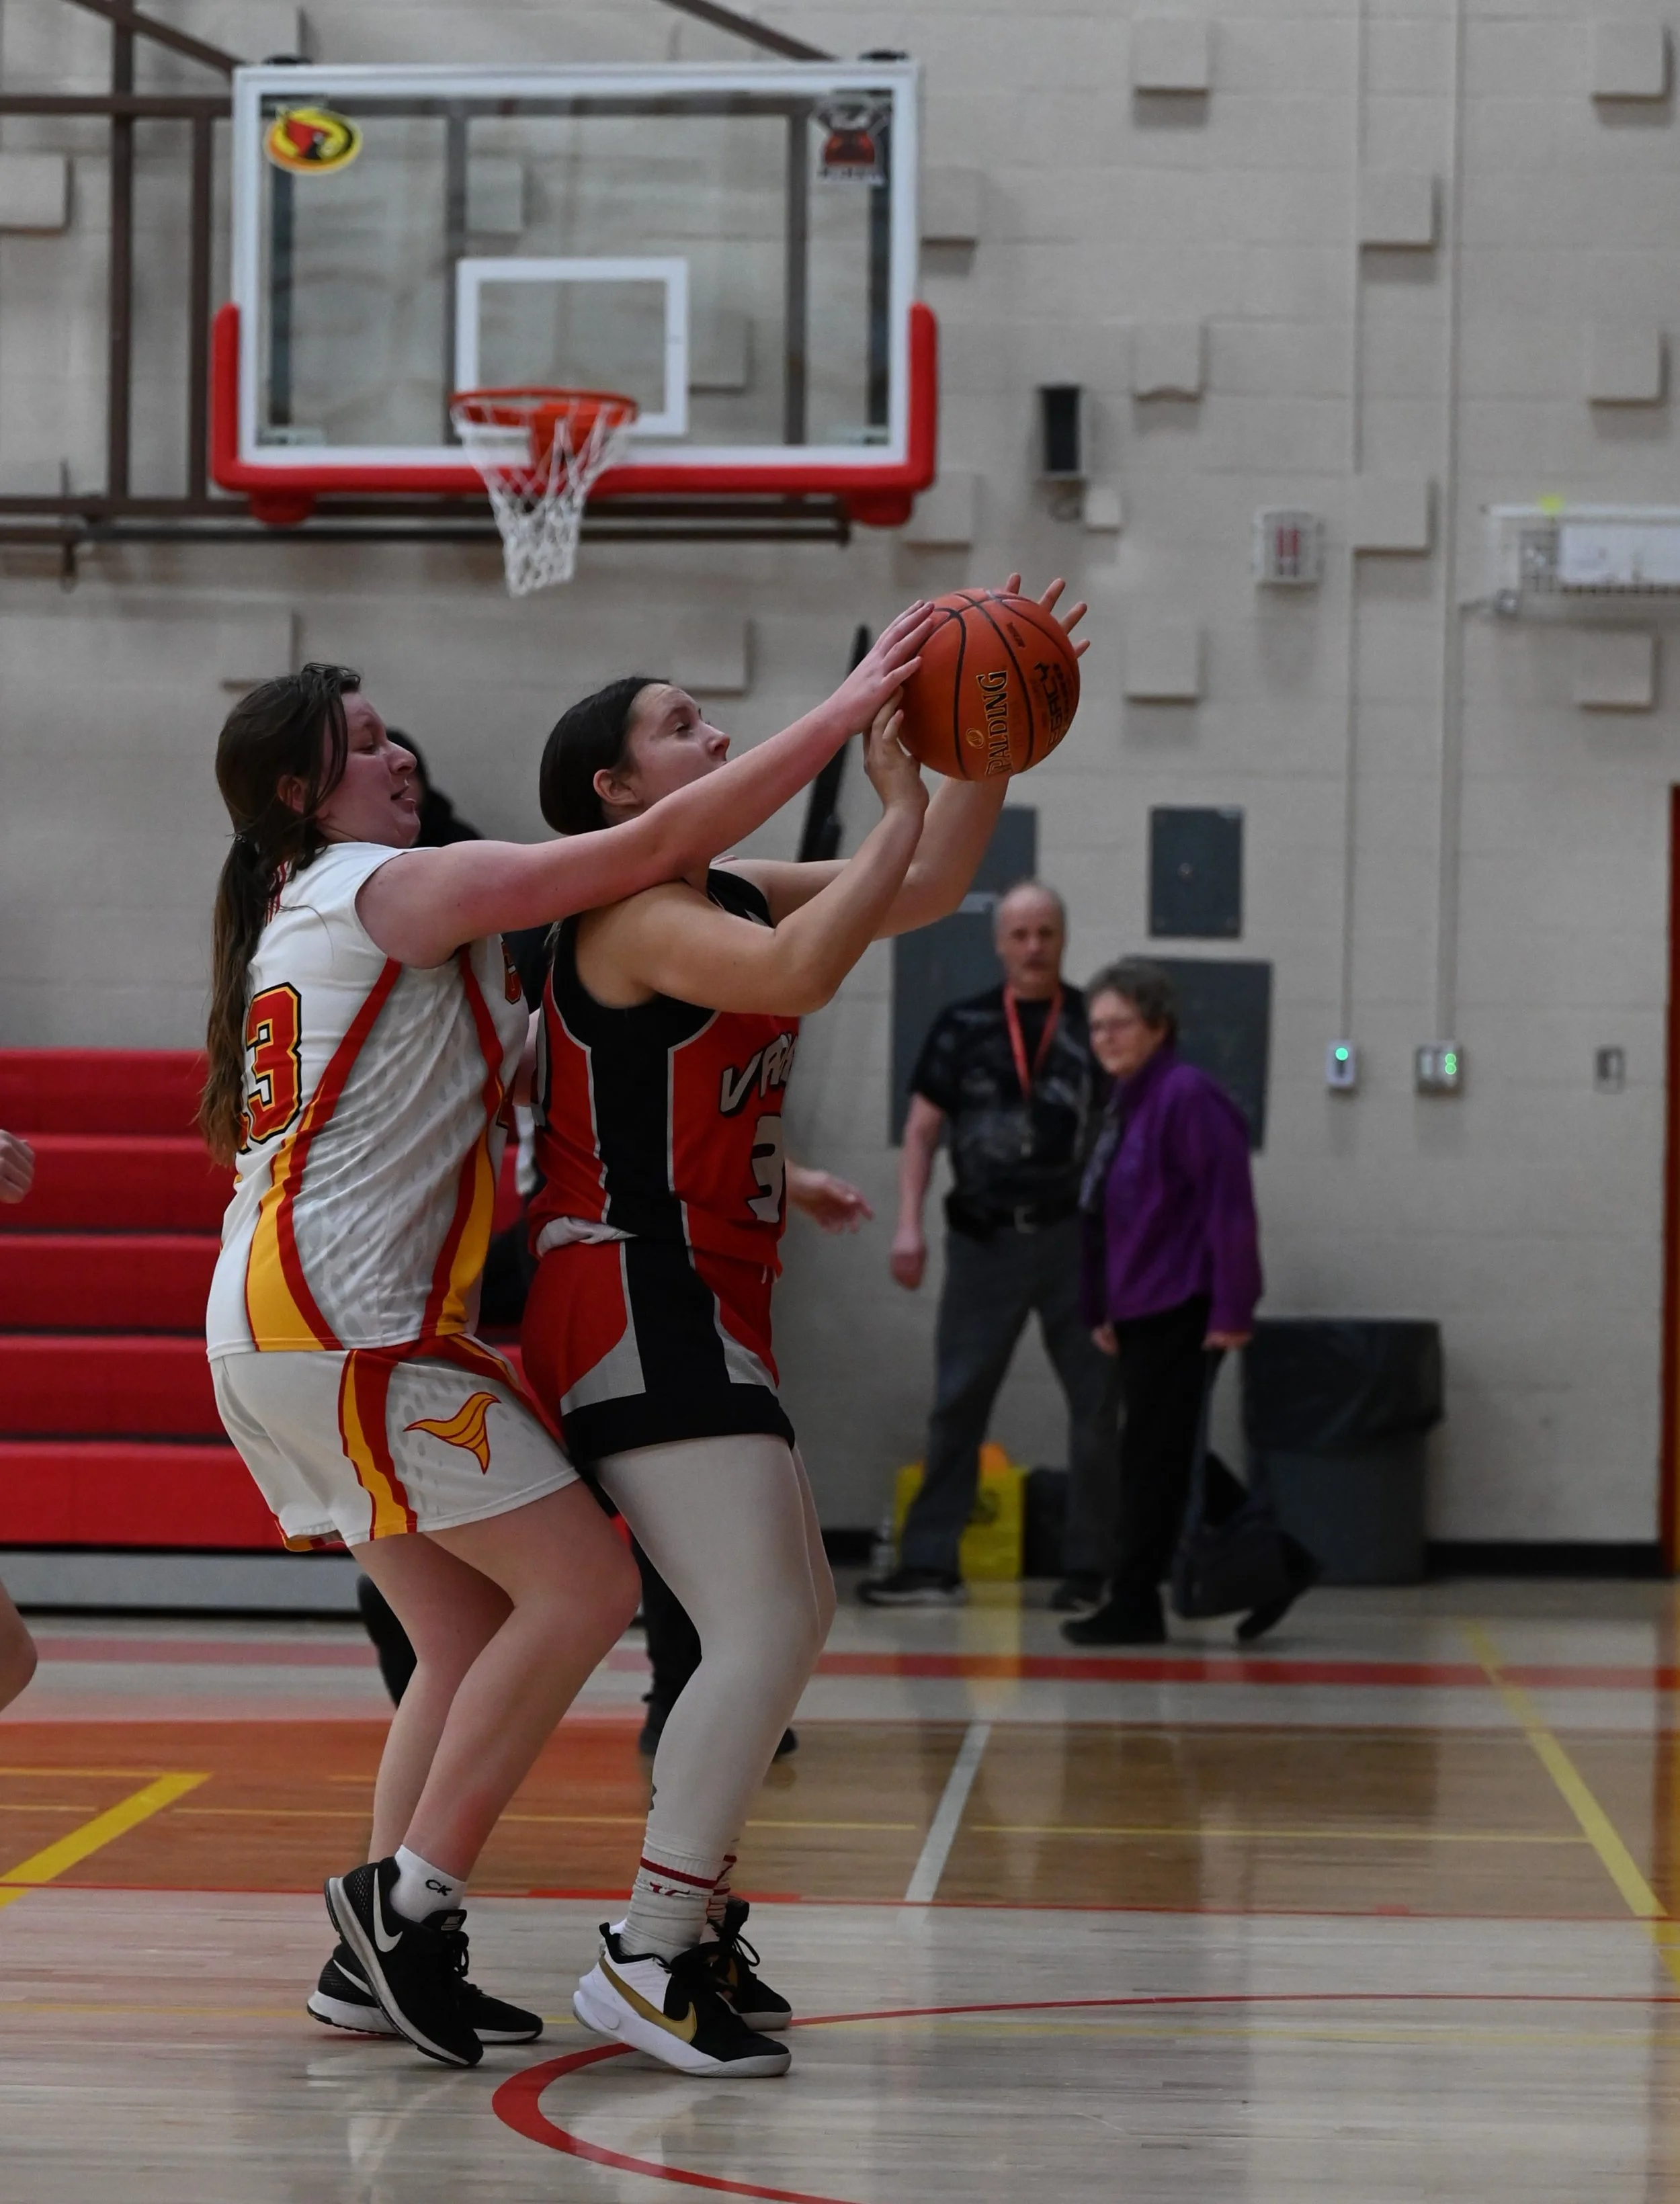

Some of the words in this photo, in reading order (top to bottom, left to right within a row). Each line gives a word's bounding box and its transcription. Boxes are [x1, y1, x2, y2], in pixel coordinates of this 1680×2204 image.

[976, 671, 1013, 777] PALDING
[237, 982, 302, 1154] 3
[425, 1879, 452, 1896] CK
